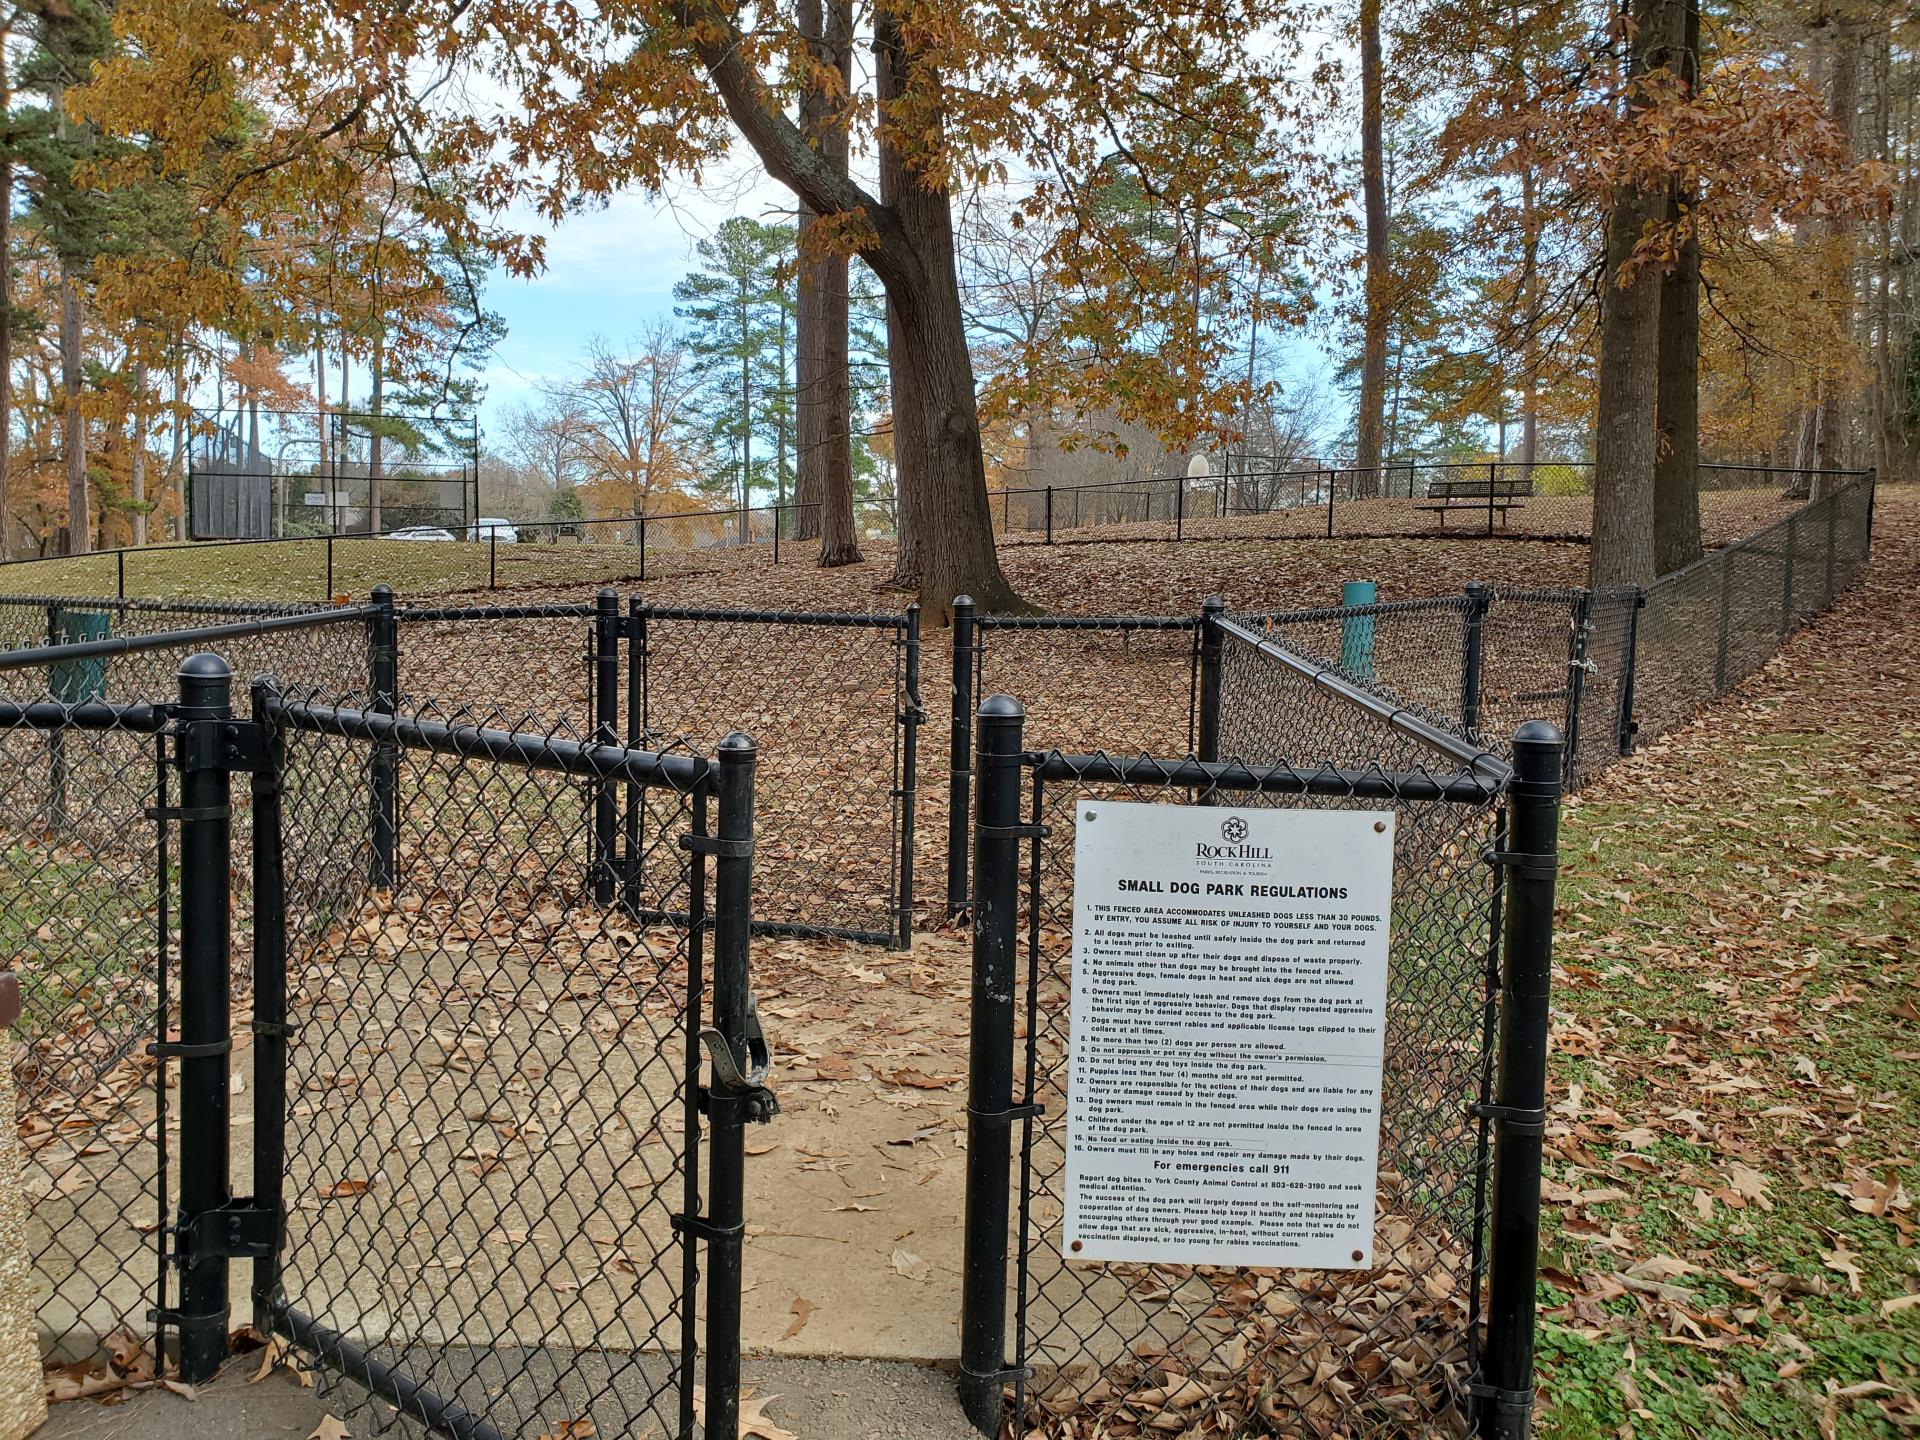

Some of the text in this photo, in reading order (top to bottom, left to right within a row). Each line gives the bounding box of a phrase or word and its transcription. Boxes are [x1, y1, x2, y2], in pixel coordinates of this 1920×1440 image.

[1196, 842, 1274, 859] ROCK HILL
[1118, 879, 1348, 900] SMALL DOG PARK REGULATIONS
[1113, 905, 1141, 913] FENCED
[1143, 907, 1164, 915] AREA
[1166, 908, 1226, 917] ACCOMMODATES
[1228, 910, 1271, 919] UNLEASHED
[1273, 912, 1294, 920] DOGS
[1316, 913, 1336, 921] THAN
[1351, 914, 1382, 922] POUNDS.
[1106, 915, 1132, 924] ENTRY,
[1135, 916, 1150, 924] YOU
[1152, 917, 1182, 925] ASSUME
[1184, 918, 1199, 926] ALL
[1200, 919, 1218, 927] RISK
[1261, 921, 1272, 929] TO
[1274, 922, 1311, 930] YOURSELF
[1331, 923, 1352, 931] YOUR
[1354, 924, 1377, 932] DOGS.
[1084, 928, 1092, 936] 2.
[1107, 930, 1125, 938] dogs
[1162, 932, 1191, 940] leashed
[1194, 934, 1211, 942] until
[1213, 935, 1237, 943] safely
[1280, 937, 1295, 945] dog
[1297, 938, 1314, 946] park
[1134, 940, 1153, 948] prior
[1166, 942, 1194, 950] exiting.
[1093, 948, 1121, 956] Owners
[1145, 950, 1166, 958] clean
[1223, 954, 1241, 962] dogs
[1261, 955, 1290, 963] dispose
[1329, 958, 1362, 966] properly.
[1137, 961, 1157, 969] other
[1179, 963, 1197, 971] dogs
[1219, 964, 1229, 972] be
[1231, 965, 1260, 974] brought
[1280, 966, 1293, 974] the
[1295, 967, 1321, 975] fenced
[1091, 1035, 1101, 1043] No
[1125, 1037, 1142, 1045] than
[1161, 1038, 1172, 1046] (2)
[1175, 1040, 1193, 1048] dogs
[1255, 1042, 1286, 1050] allowed.
[1090, 1056, 1100, 1064] Do
[1117, 1058, 1137, 1067] bring
[1155, 1060, 1169, 1068] dog
[1172, 1060, 1188, 1068] toys
[1191, 1061, 1213, 1069] inside
[1231, 1062, 1245, 1071] dog
[1247, 1063, 1267, 1071] park.
[1089, 1067, 1119, 1076] Puppies
[1121, 1068, 1137, 1076] less
[1140, 1069, 1157, 1077] than
[1159, 1070, 1175, 1078] four
[1177, 1070, 1189, 1079] (4)
[1130, 1137, 1154, 1145] eating
[1156, 1137, 1179, 1145] inside
[1197, 1139, 1211, 1147] dog
[1154, 1160, 1290, 1174] For emergencies call 911
[1079, 1174, 1104, 1182] Report
[1106, 1175, 1121, 1184] dog
[1155, 1177, 1171, 1185] York
[1174, 1178, 1200, 1187] County
[1202, 1179, 1228, 1187] Animal
[1231, 1180, 1258, 1188] Control
[1271, 1181, 1326, 1190] 803-628-3190
[1111, 1184, 1146, 1192] attention.
[1078, 1233, 1120, 1241] vaccination
[1122, 1234, 1160, 1244] displayed,
[1188, 1238, 1210, 1246] young
[1226, 1238, 1250, 1246] rabies
